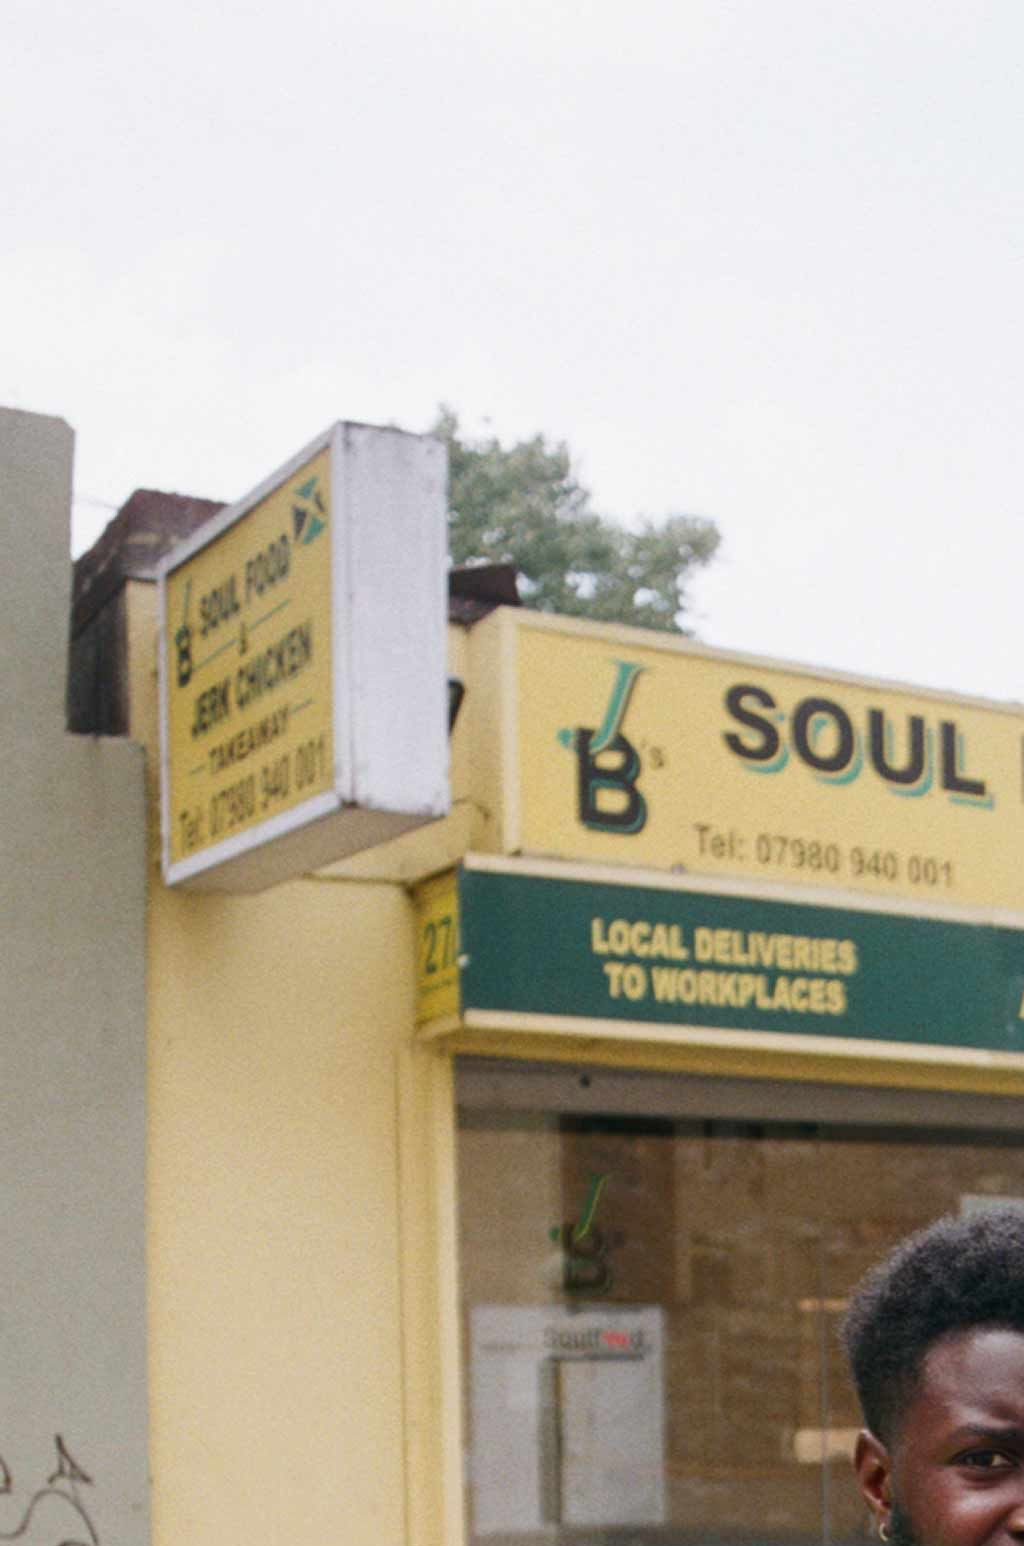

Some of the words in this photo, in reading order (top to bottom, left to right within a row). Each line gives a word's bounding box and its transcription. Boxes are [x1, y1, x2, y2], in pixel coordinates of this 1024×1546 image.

[200, 572, 241, 638] SOUL
[245, 532, 291, 606] FOOD
[191, 674, 232, 741] JERK
[235, 619, 314, 712] CHICKEN
[209, 701, 289, 777] TAKEAWAY
[295, 732, 326, 791] 001
[721, 684, 994, 809] SOUL
[694, 823, 747, 863] Tel:
[755, 833, 842, 874] 07980
[848, 841, 899, 882] 940
[906, 853, 956, 889] 001
[591, 915, 686, 961] LOCAL
[692, 925, 858, 976] DELIVERIES
[604, 961, 642, 999] TO
[650, 964, 848, 1016] WORKPLACES
